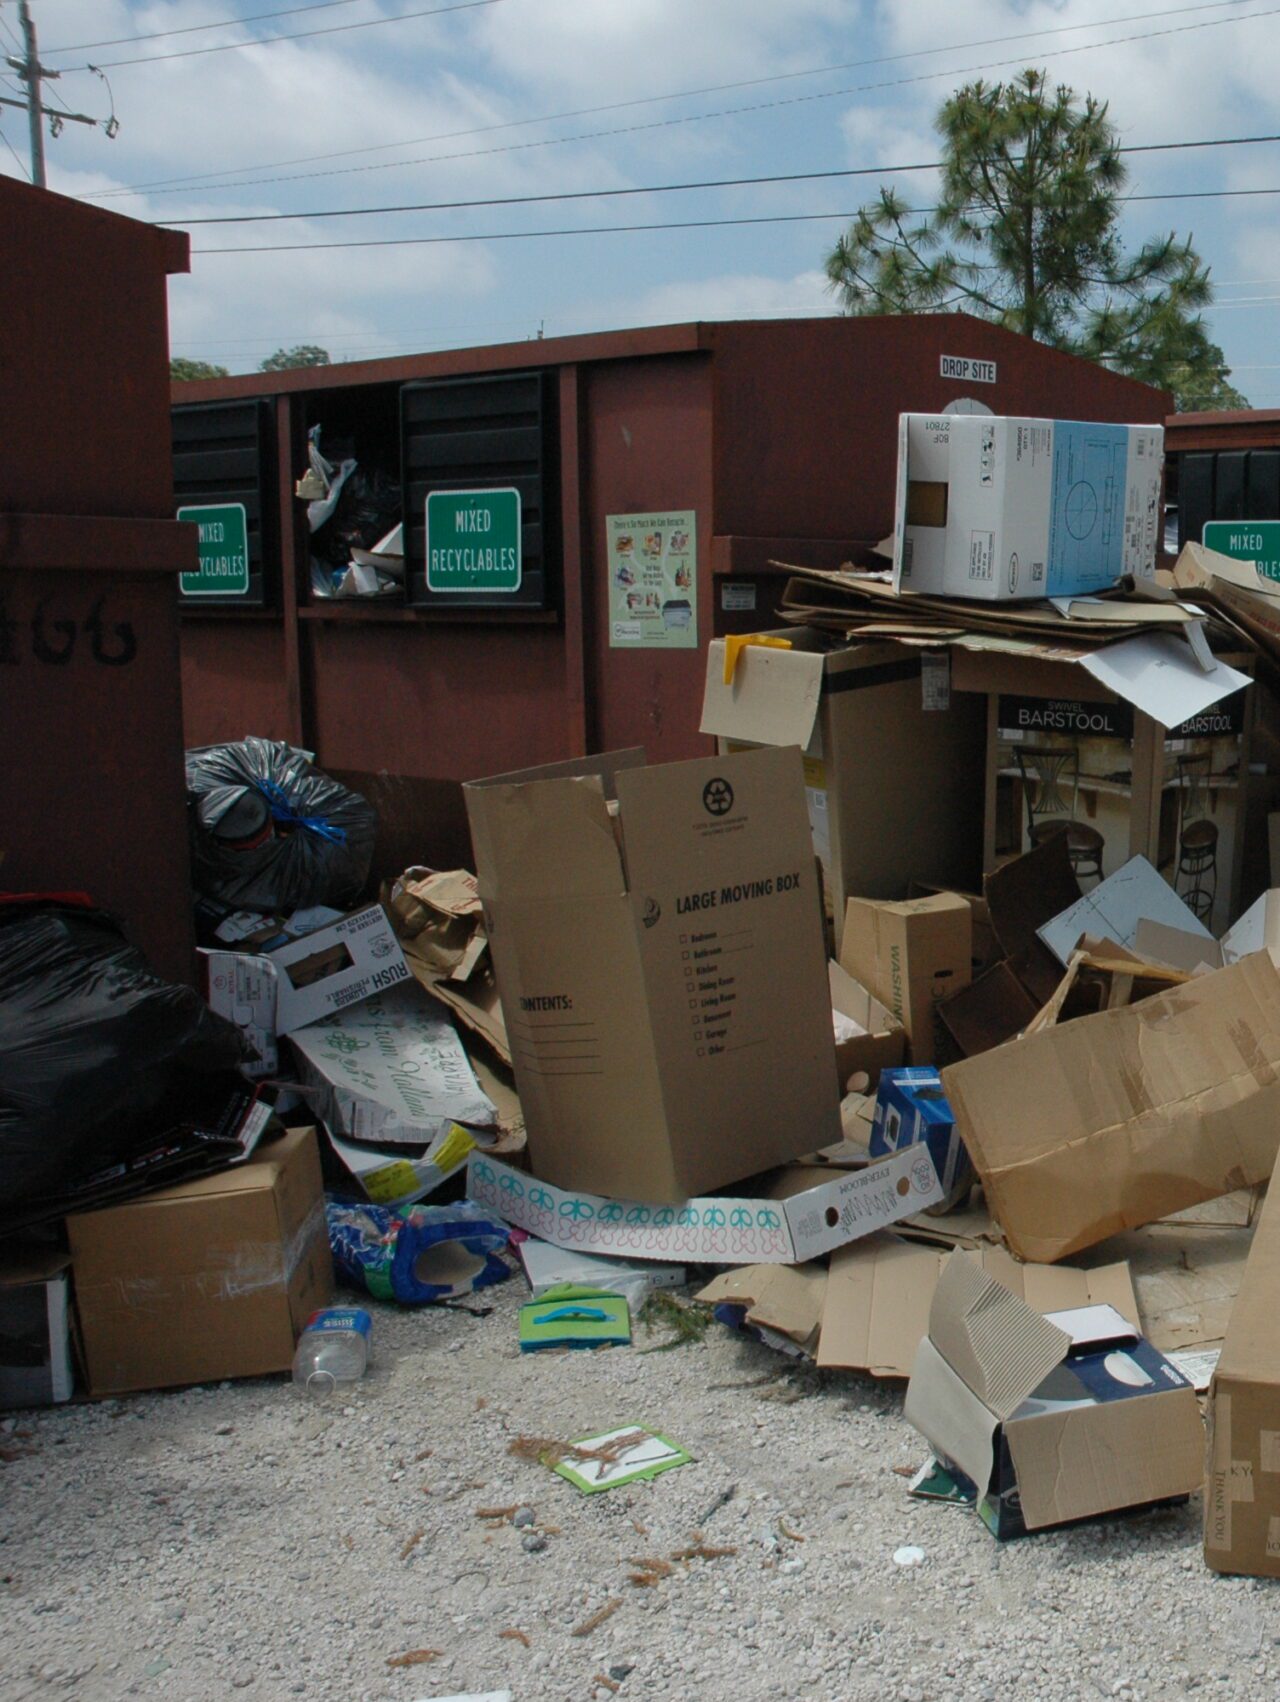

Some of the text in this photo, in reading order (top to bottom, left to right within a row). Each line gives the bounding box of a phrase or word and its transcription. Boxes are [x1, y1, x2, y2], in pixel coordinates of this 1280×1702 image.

[942, 357, 995, 381] DROP SITE
[199, 522, 225, 543] MIXED
[456, 509, 491, 533] MIXED
[1230, 534, 1263, 550] MIXED
[183, 555, 245, 578] YCLABLES
[432, 547, 515, 572] RECYCLABLES
[1047, 700, 1084, 713] SWIVEL
[1018, 709, 1114, 733] BARSTOOL
[1181, 715, 1232, 734] BARSTOOL
[676, 872, 800, 915] LARGE MOVING BOX
[690, 931, 718, 944] Bedroom
[372, 960, 409, 990] RUSH
[696, 962, 719, 976] Kitchen
[325, 975, 371, 1003] PERISHABLE
[698, 976, 736, 992] Dining Room
[700, 992, 737, 1009] Living Room
[708, 1043, 726, 1056] Other
[387, 1060, 446, 1118] Holland
[839, 1167, 890, 1194] EVER-BLOOM
[1214, 1471, 1226, 1542] THANK YOU
